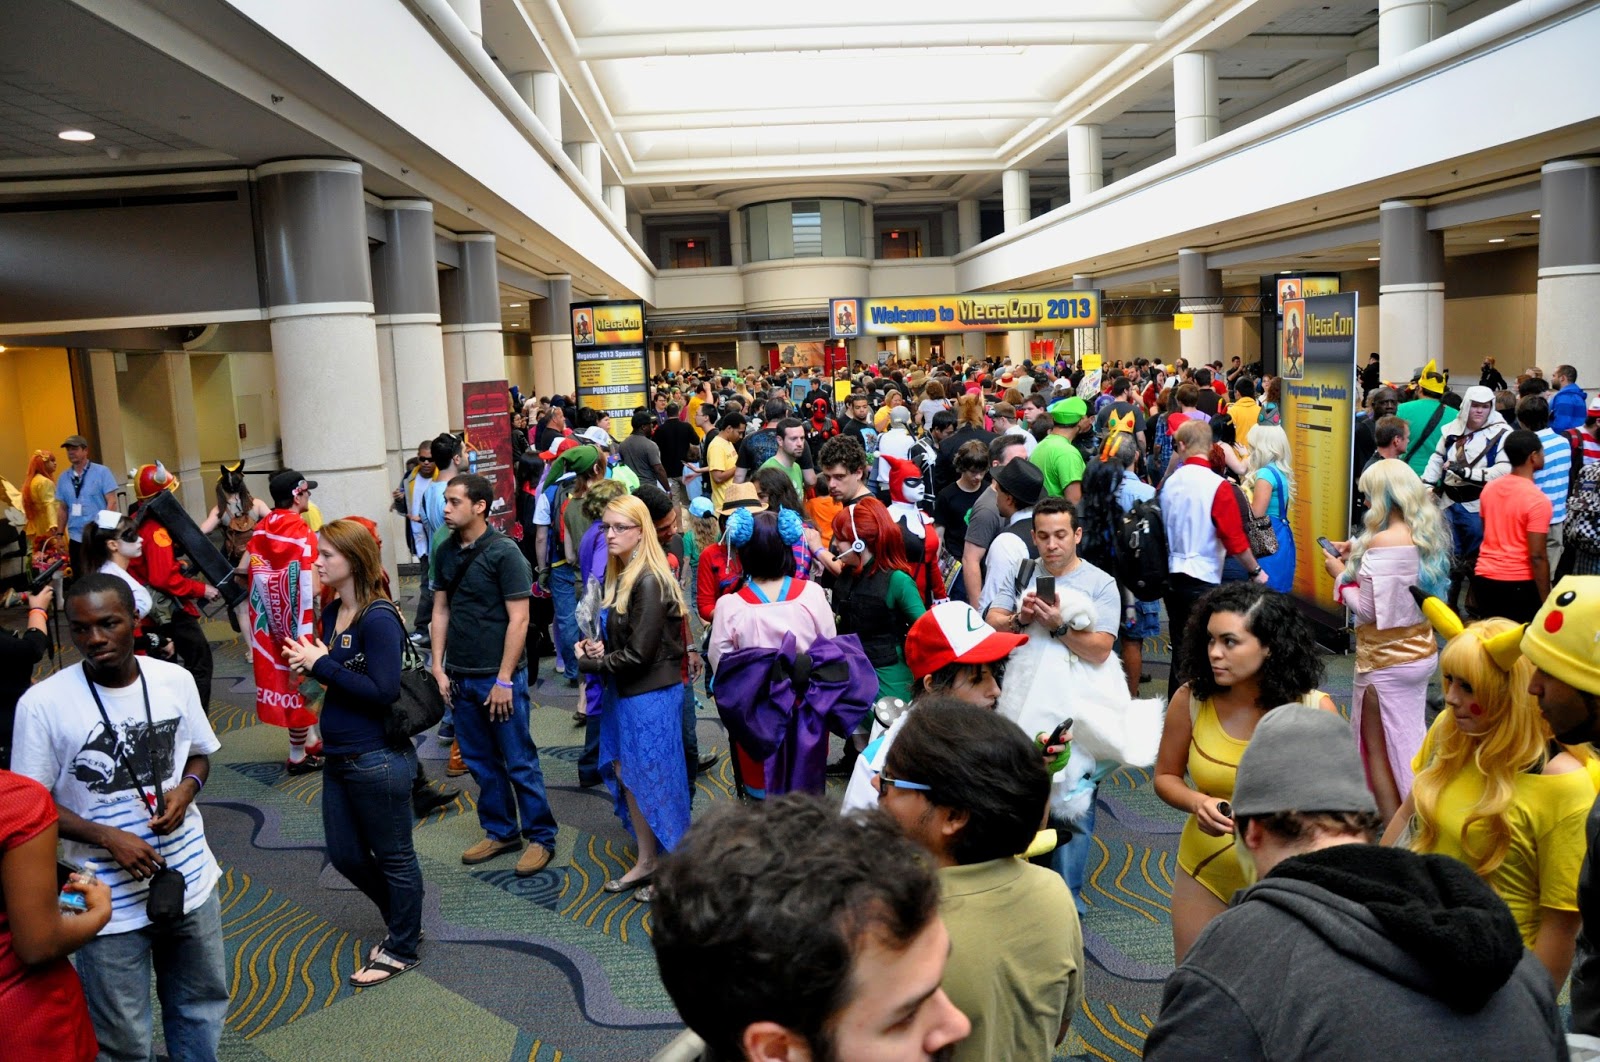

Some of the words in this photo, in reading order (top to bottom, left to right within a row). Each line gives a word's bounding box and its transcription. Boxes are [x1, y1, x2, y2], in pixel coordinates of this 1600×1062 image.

[871, 306, 936, 324] Welcome
[939, 305, 954, 321] to
[957, 298, 1043, 325] MegaCon
[1047, 298, 1091, 319] 2013
[596, 318, 641, 331] MegaCon
[1306, 312, 1353, 339] MegaCon
[576, 352, 599, 360] Megacon
[615, 350, 642, 358] Sponsors:
[592, 385, 629, 394] PUBLISHERS
[1287, 382, 1320, 401] Programming
[269, 574, 283, 632] LIVERPOO
